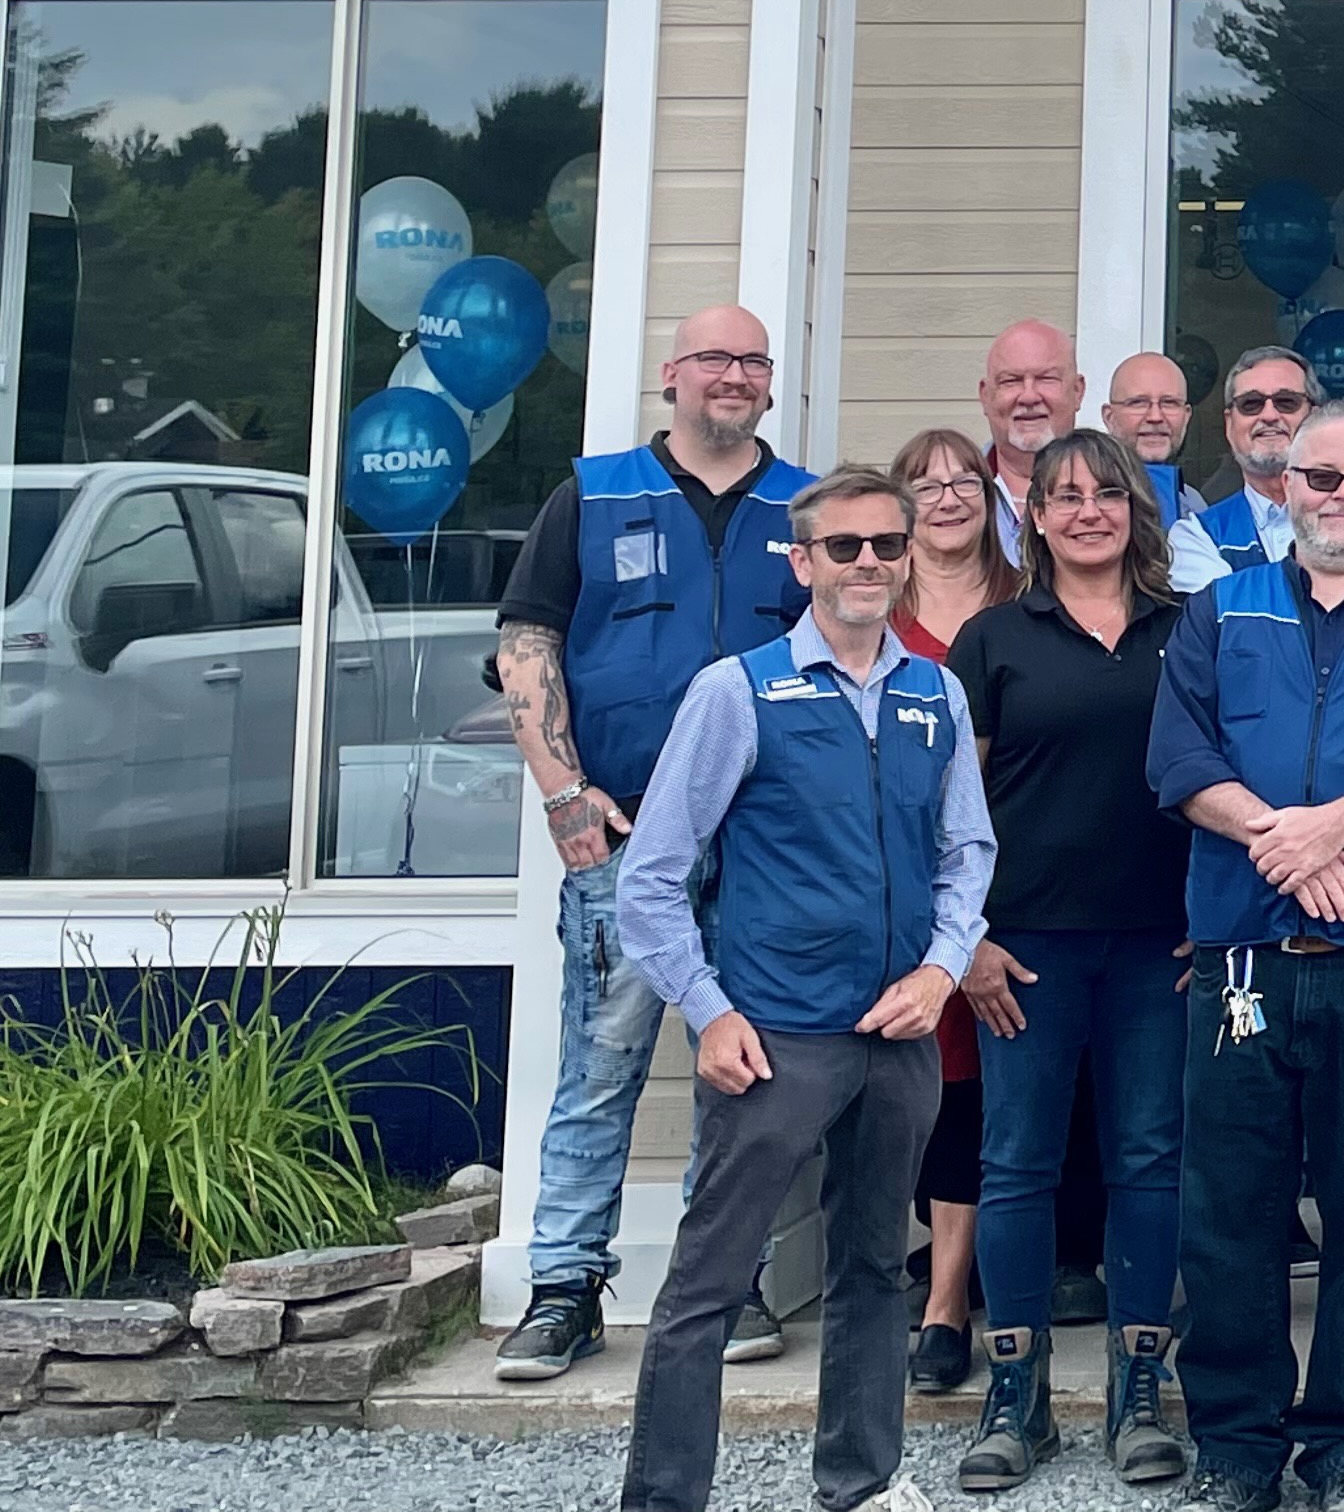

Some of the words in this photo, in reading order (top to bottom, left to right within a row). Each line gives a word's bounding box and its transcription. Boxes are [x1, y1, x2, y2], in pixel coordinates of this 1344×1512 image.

[375, 227, 463, 253] RONA
[418, 314, 463, 338] ONA
[362, 447, 452, 473] RONA
[766, 540, 791, 555] RO
